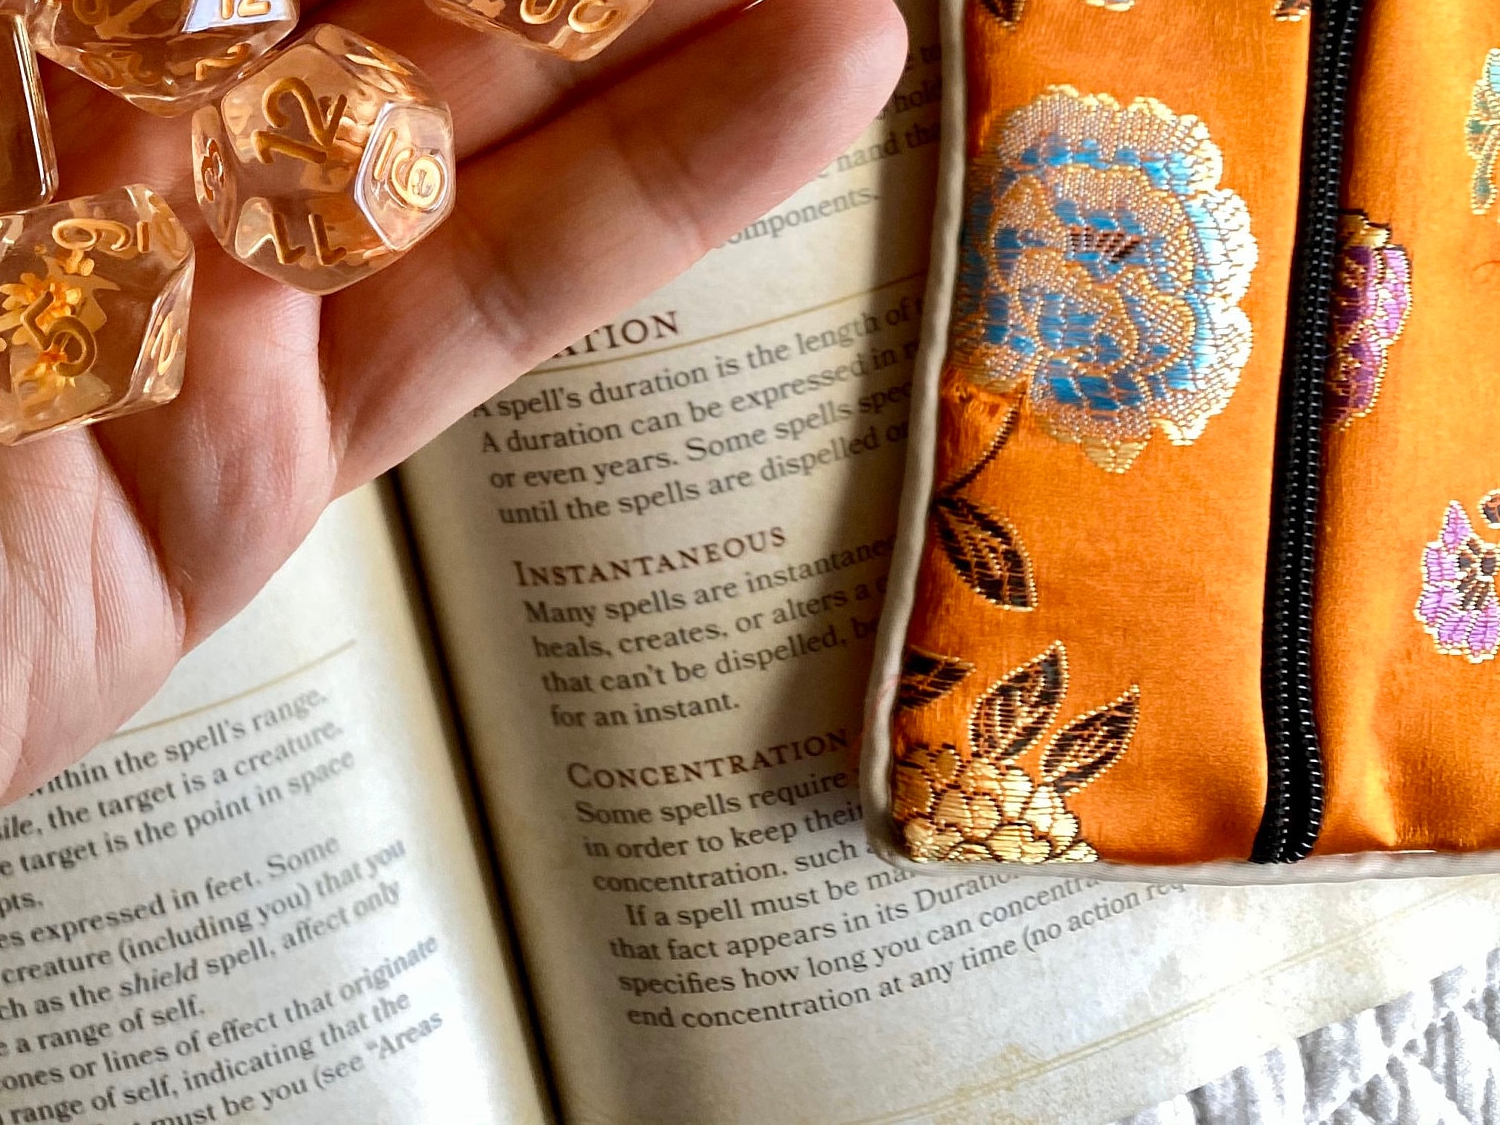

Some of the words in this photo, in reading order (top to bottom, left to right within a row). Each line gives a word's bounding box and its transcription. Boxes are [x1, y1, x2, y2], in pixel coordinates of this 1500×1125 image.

[252, 77, 347, 164] 12
[20, 291, 97, 377] 5
[482, 430, 502, 453] A
[505, 423, 623, 453] duration
[630, 411, 683, 436] can
[686, 400, 722, 423] be
[729, 353, 869, 413] expressed
[512, 526, 786, 587] INSTANTANEOUS
[523, 600, 596, 627] Many
[604, 589, 687, 623] spells
[694, 582, 738, 606] are
[550, 703, 586, 728] for
[594, 710, 629, 728] an
[567, 727, 853, 789] CONCENTRATION
[114, 751, 157, 776] the
[30, 893, 167, 943] expressed
[171, 889, 200, 910] in
[266, 837, 337, 879] Some
[34, 996, 65, 1015] as
[69, 984, 111, 1008] the
[119, 957, 199, 998] shield
[282, 907, 349, 950] affect
[352, 880, 400, 920] only
[626, 1006, 677, 1028] end
[681, 987, 871, 1028] concentration
[879, 976, 904, 998] at
[909, 961, 954, 989] any
[960, 939, 1018, 971] time
[1022, 923, 1062, 953] (no
[1067, 891, 1141, 932] action
